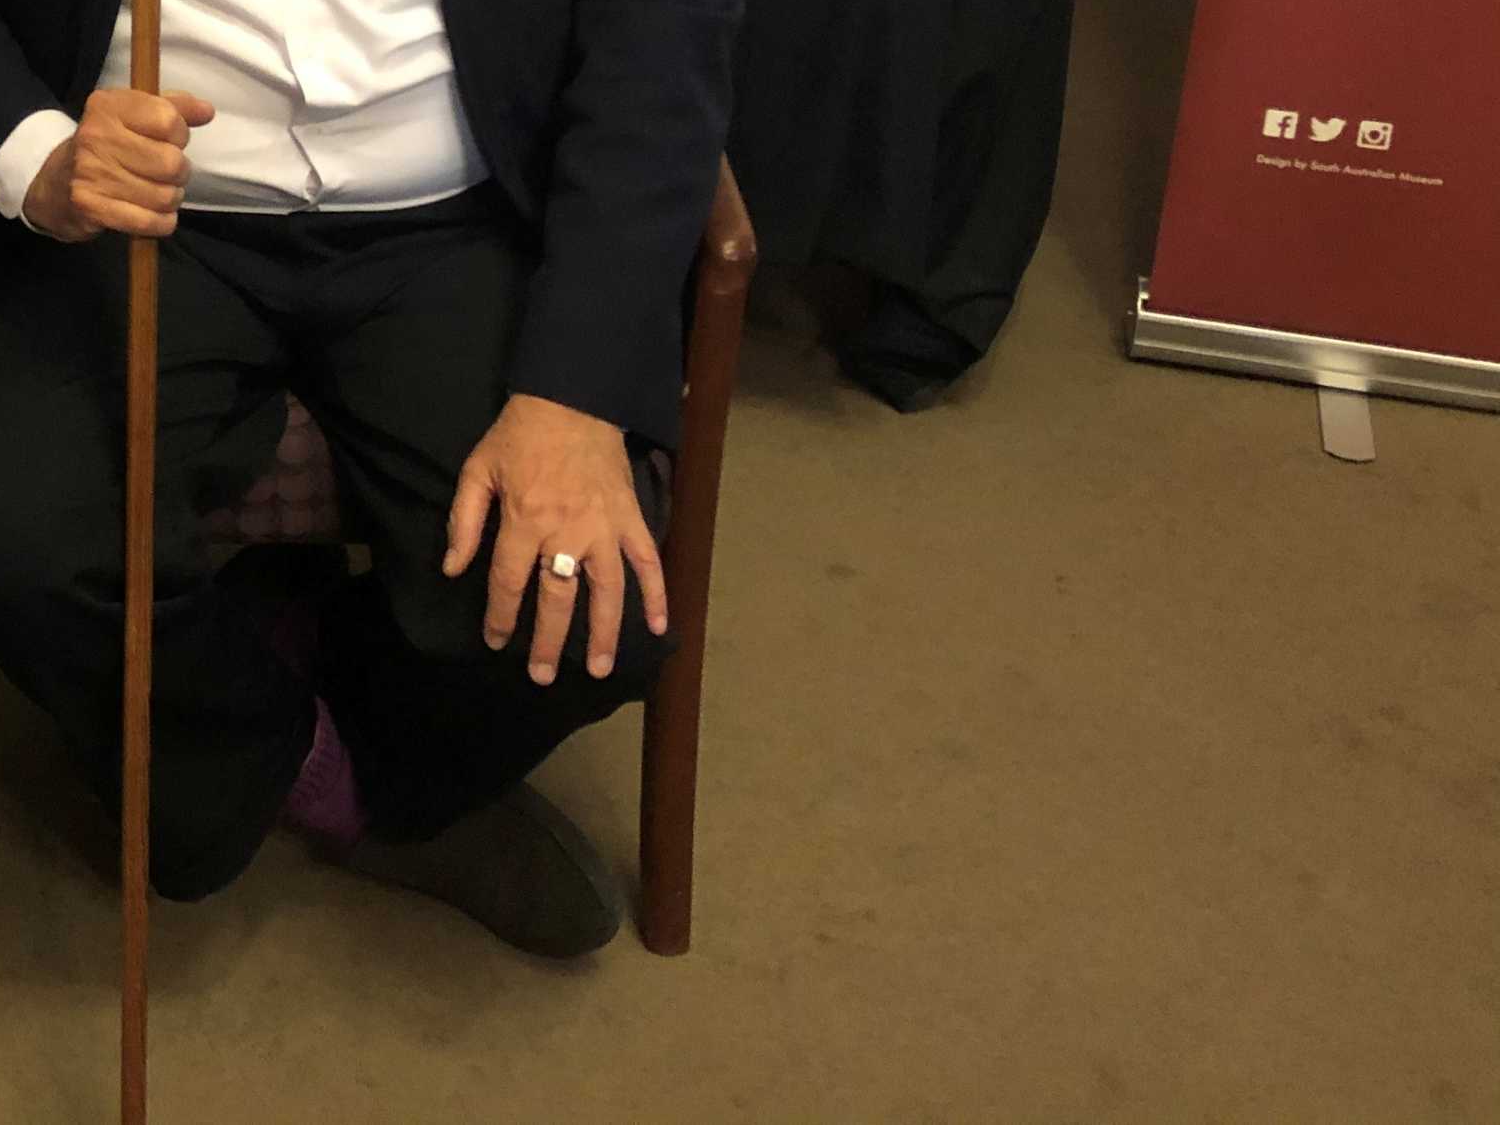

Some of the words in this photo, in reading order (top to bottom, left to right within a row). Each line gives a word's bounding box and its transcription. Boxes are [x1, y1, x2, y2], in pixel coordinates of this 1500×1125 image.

[1255, 153, 1291, 169] Design
[1294, 159, 1307, 170] by
[1310, 160, 1340, 173] South
[1342, 165, 1396, 180] Australian
[1398, 172, 1444, 186] Museum
